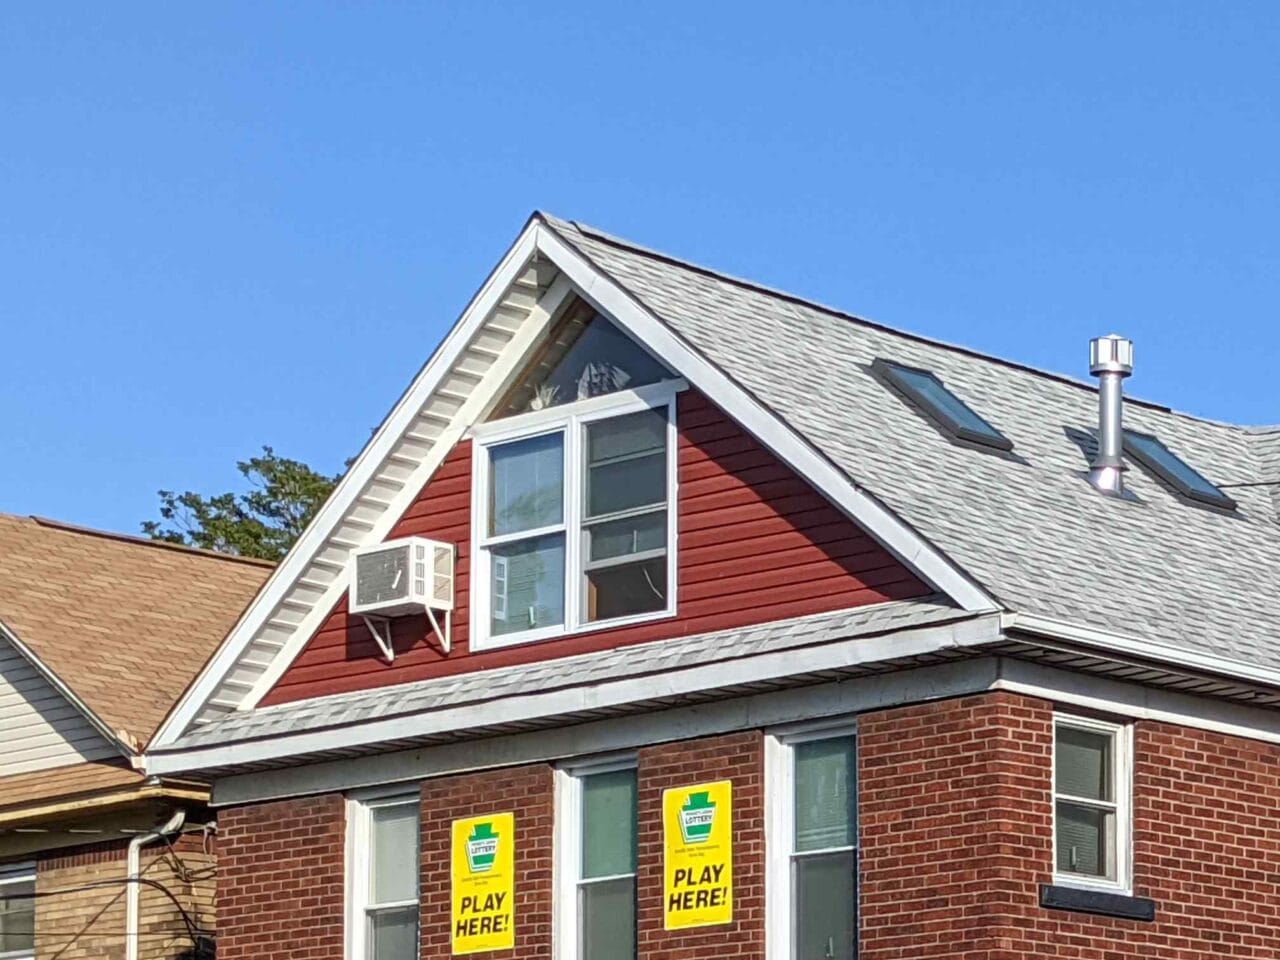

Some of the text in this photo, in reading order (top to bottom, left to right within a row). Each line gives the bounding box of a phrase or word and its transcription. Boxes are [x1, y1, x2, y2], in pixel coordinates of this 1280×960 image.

[673, 863, 725, 888] PLAY
[460, 891, 507, 914] PLAY
[668, 886, 728, 912] HERE!
[456, 914, 509, 938] HERE!
